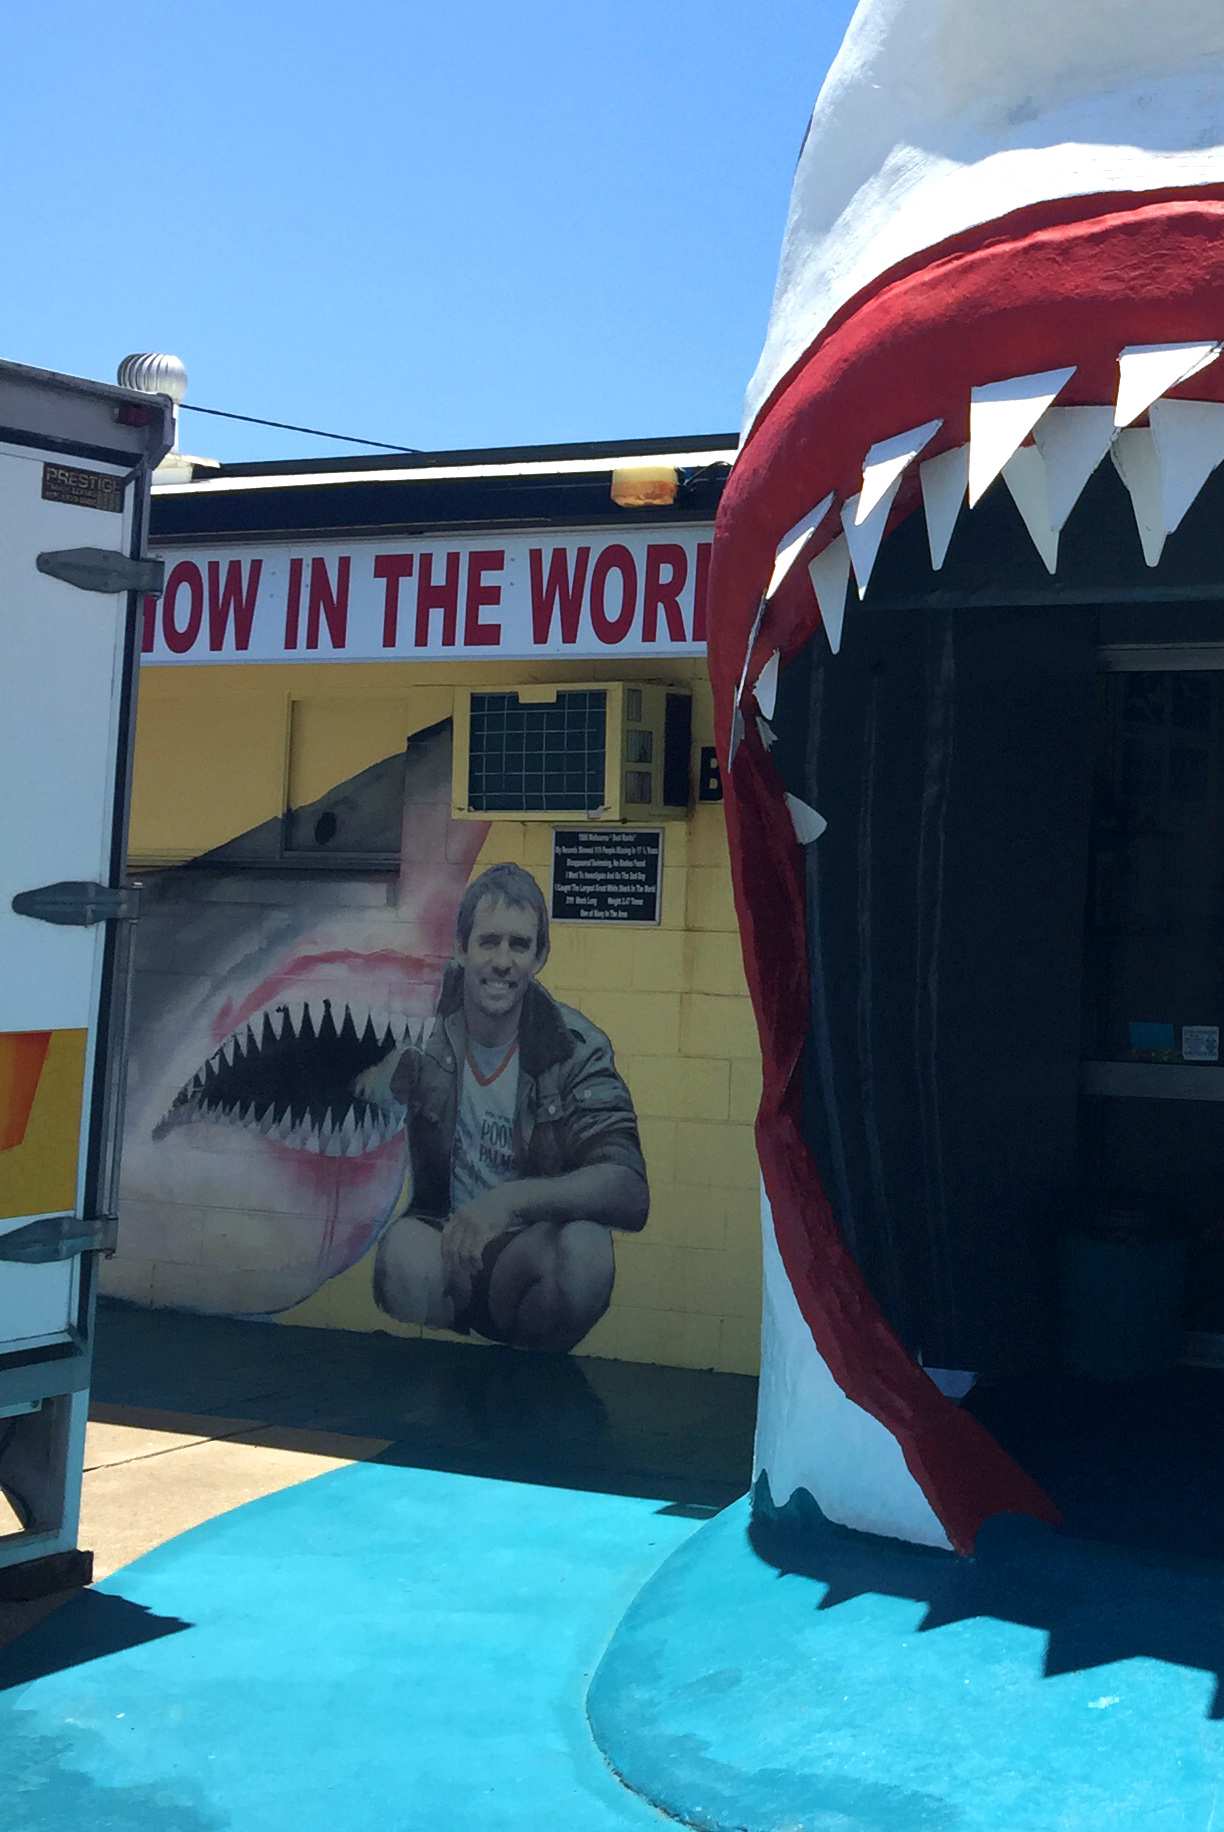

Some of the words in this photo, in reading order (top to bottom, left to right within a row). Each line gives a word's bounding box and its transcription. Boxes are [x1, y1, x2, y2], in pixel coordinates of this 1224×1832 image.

[46, 466, 121, 495] PRESTIGE
[284, 556, 351, 650] IN
[373, 549, 505, 648] THE
